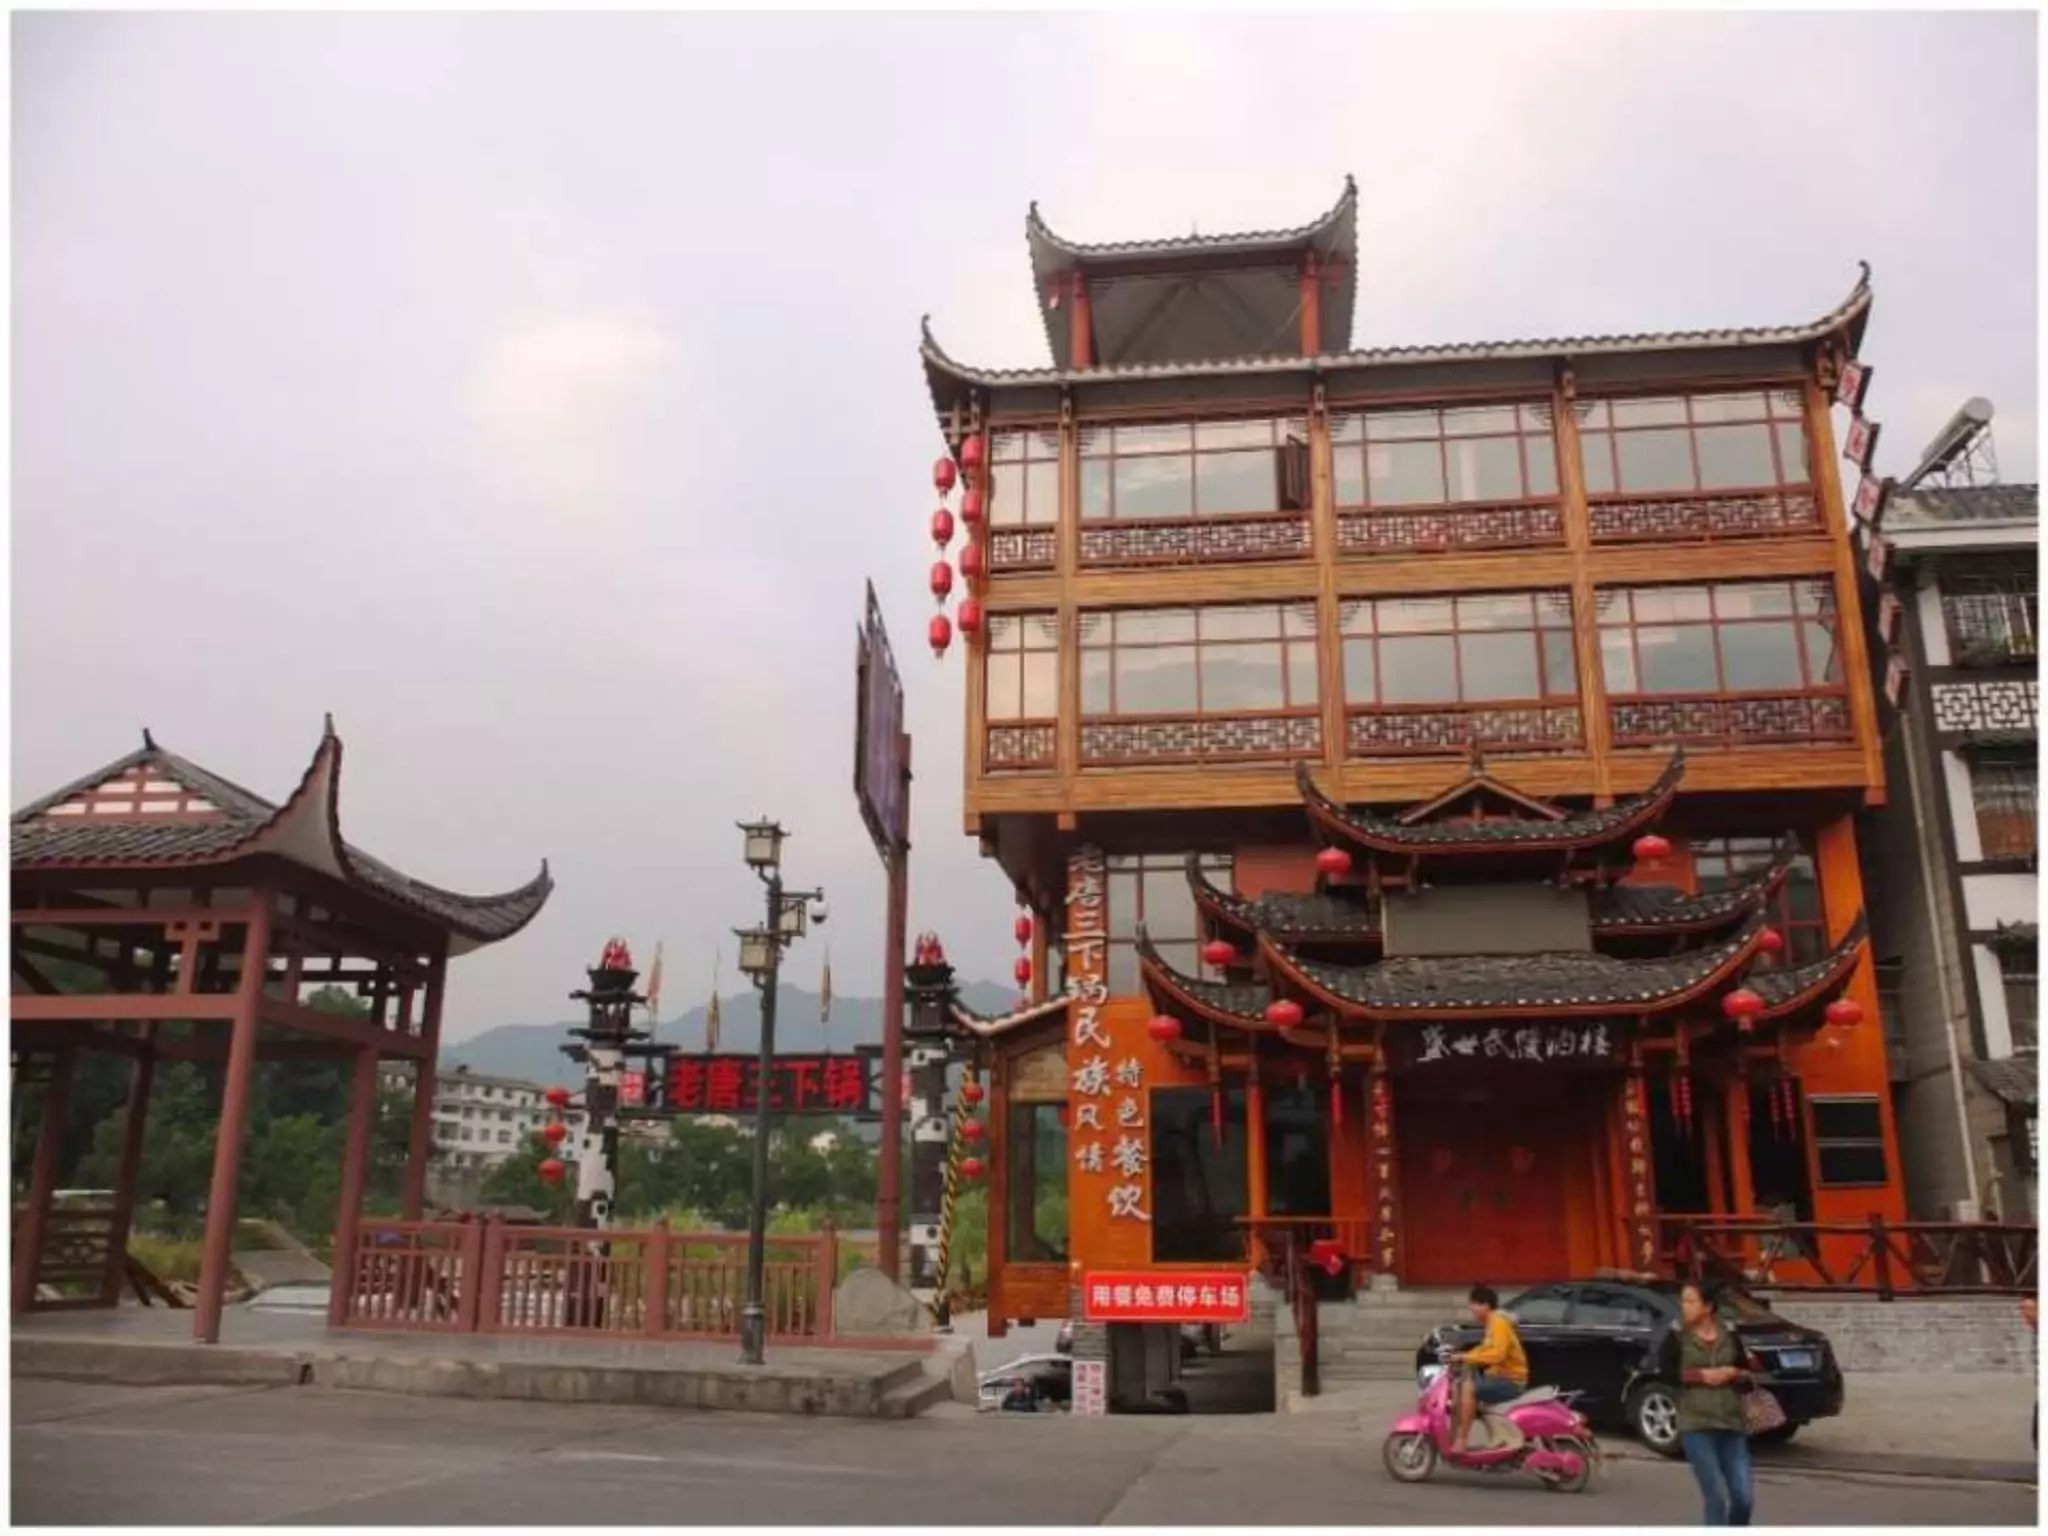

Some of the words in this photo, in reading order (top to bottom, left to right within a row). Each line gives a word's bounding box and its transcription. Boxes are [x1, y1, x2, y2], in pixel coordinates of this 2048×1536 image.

[667, 1057, 865, 1111] 老唐三下锅
[1107, 1056, 1152, 1222] 特色餐饮
[1091, 1284, 1241, 1308] 用餐免费停车场
